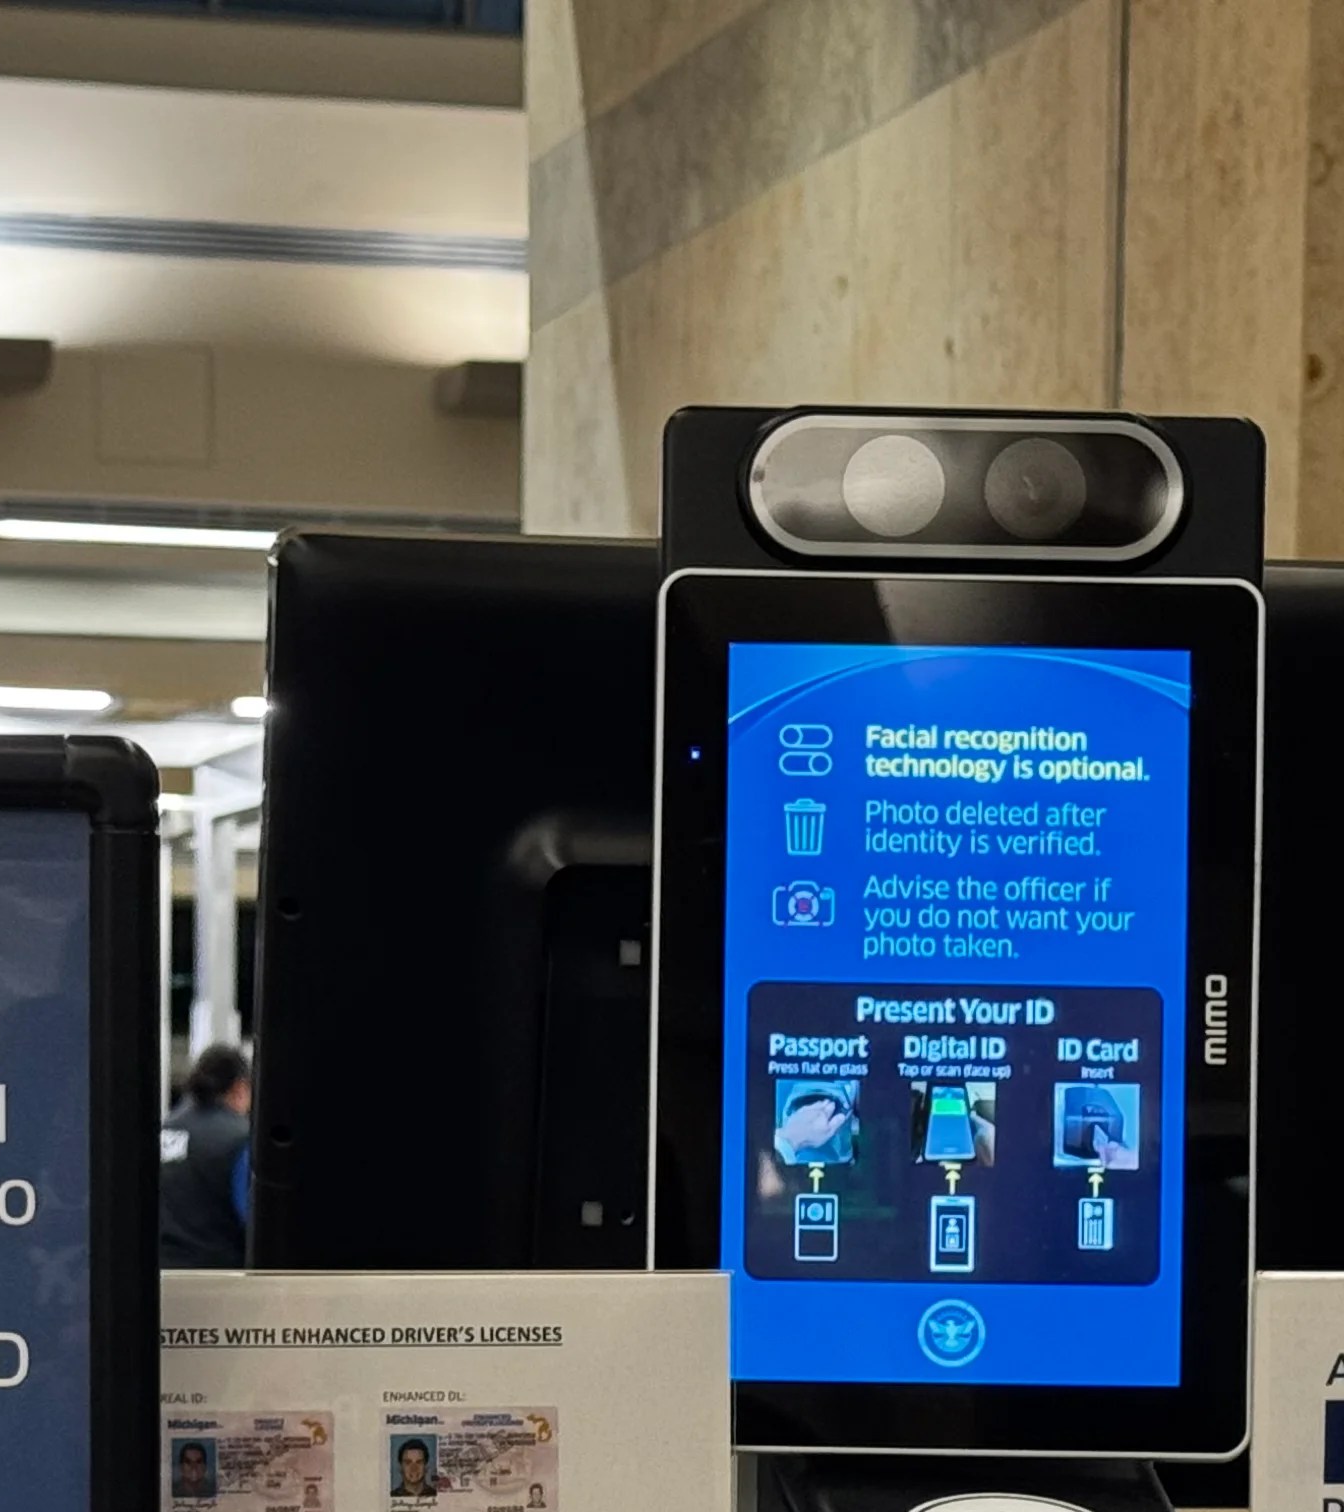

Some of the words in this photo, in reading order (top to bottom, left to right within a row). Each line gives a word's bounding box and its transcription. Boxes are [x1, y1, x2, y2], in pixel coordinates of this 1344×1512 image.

[866, 724, 937, 749] Facial
[944, 726, 1087, 754] recognition
[866, 753, 1007, 783] technology
[1014, 755, 1033, 779] is
[1038, 756, 1150, 784] optional.
[866, 800, 939, 824] Photo
[946, 801, 1038, 826] deleted
[1046, 802, 1107, 827] after
[866, 828, 962, 858] identity
[971, 829, 990, 854] is
[997, 831, 1101, 856] verified.
[864, 874, 950, 899] Advise
[957, 876, 997, 900] the
[1004, 877, 1086, 902] officer
[1094, 878, 1112, 902] if
[864, 908, 910, 931] you
[918, 904, 950, 928] do
[958, 906, 999, 929] not
[1006, 908, 1068, 930] want
[1076, 911, 1135, 935] your
[864, 932, 936, 959] photo
[943, 933, 1019, 958] taken.
[857, 997, 956, 1023] Present
[959, 998, 1022, 1024] Your
[1026, 999, 1054, 1024] ID
[1205, 973, 1228, 1065] mimo
[770, 1034, 869, 1060] Passport
[904, 1035, 976, 1062] Digital
[981, 1037, 1006, 1059] ID
[1058, 1039, 1082, 1060] ID
[1086, 1039, 1138, 1062] Card
[1081, 1067, 1114, 1079] Insert
[160, 1328, 218, 1344] STATES
[225, 1328, 275, 1344] WITH
[282, 1327, 385, 1343] ENHANCED
[480, 1326, 563, 1343] LICENSES
